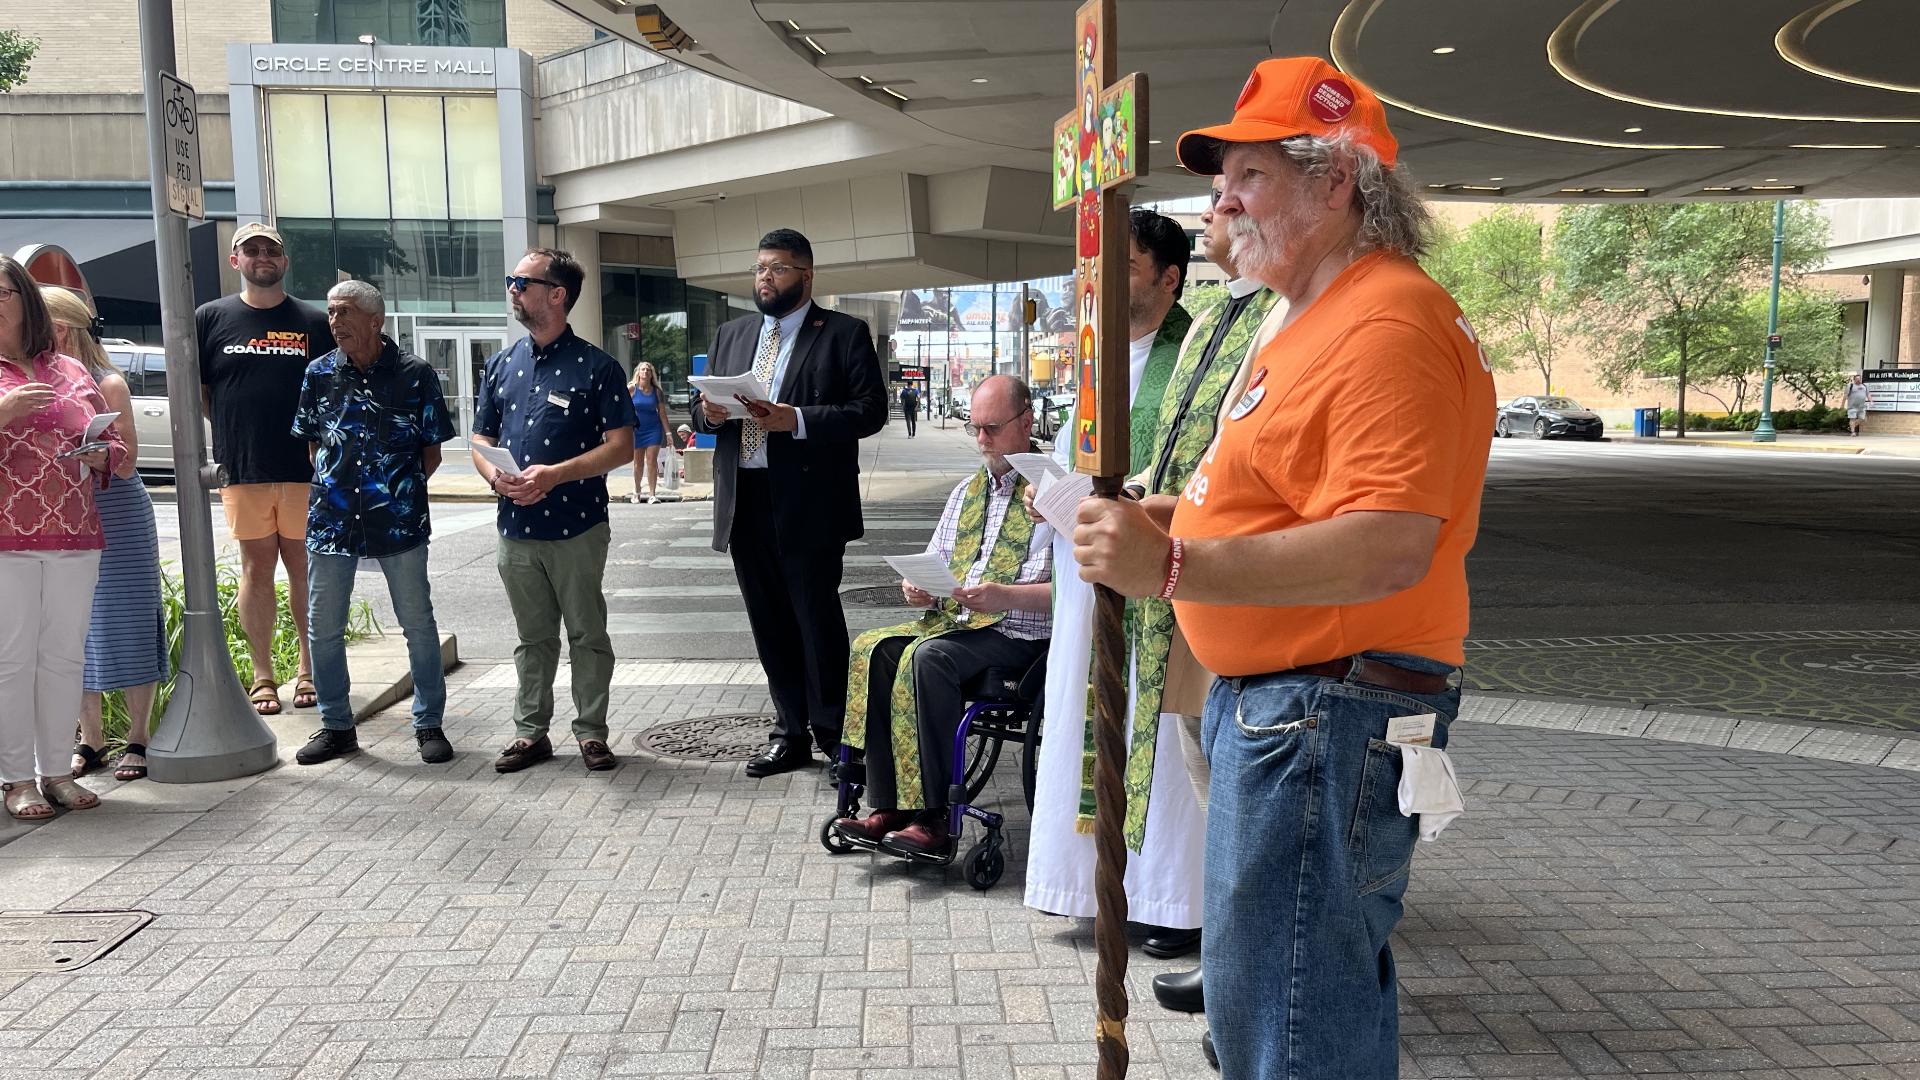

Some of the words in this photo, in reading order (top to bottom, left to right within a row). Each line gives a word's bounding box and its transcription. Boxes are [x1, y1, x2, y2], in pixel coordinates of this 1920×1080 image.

[253, 57, 331, 72] CIRCLE
[338, 58, 428, 73] CENTRE
[434, 60, 494, 75] MALL
[1317, 87, 1345, 108] DEMAND
[1321, 83, 1340, 98] MOMS
[1314, 92, 1339, 110] ACTION
[175, 137, 190, 159] USE
[176, 162, 191, 182] PED
[172, 183, 199, 207] SIGNAL
[248, 338, 305, 349] ACTION
[267, 331, 304, 341] INDY
[223, 345, 306, 356] COALITION
[1184, 473, 1209, 506] ce
[1162, 560, 1180, 598] ACTION
